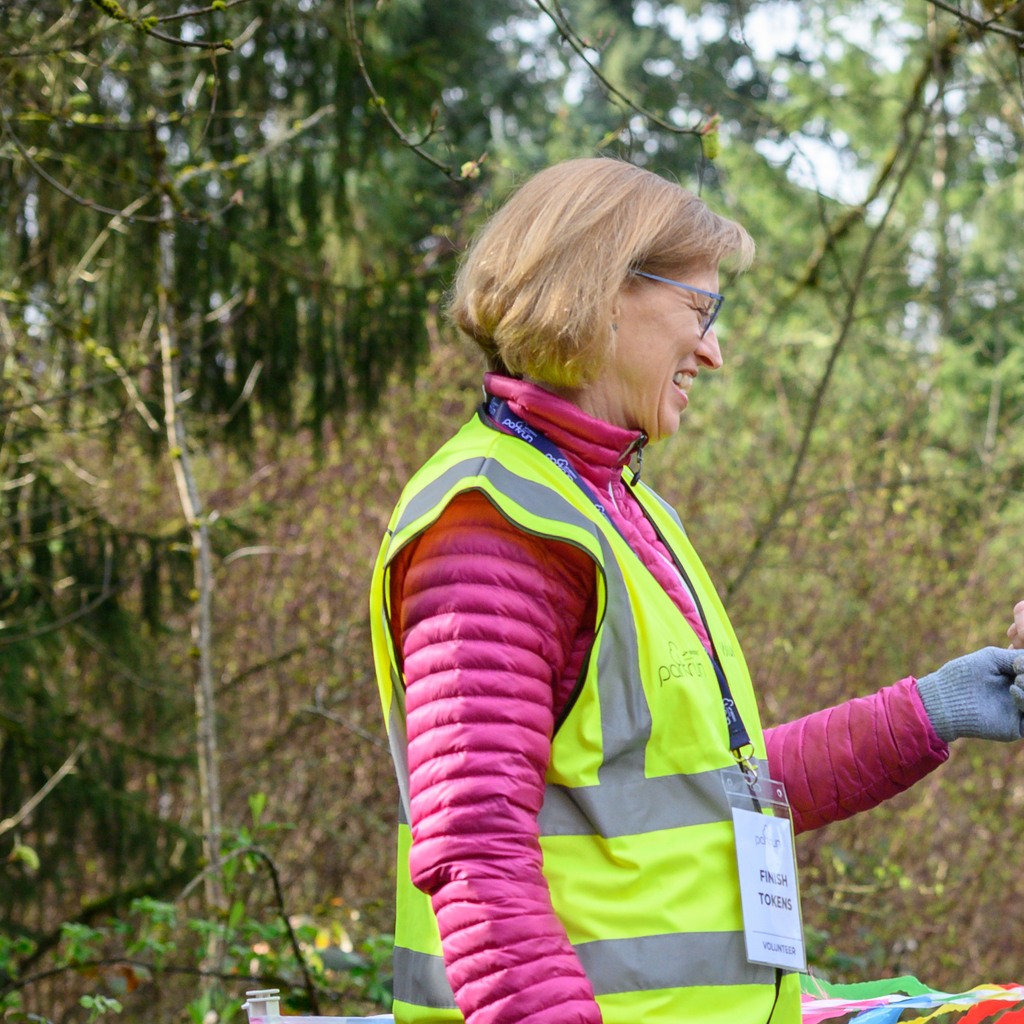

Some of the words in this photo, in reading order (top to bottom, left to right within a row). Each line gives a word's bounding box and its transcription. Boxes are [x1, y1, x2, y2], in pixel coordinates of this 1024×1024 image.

[760, 870, 788, 887] FINISH
[758, 892, 793, 911] TOKENS
[762, 940, 796, 955] VOLUNTEER
